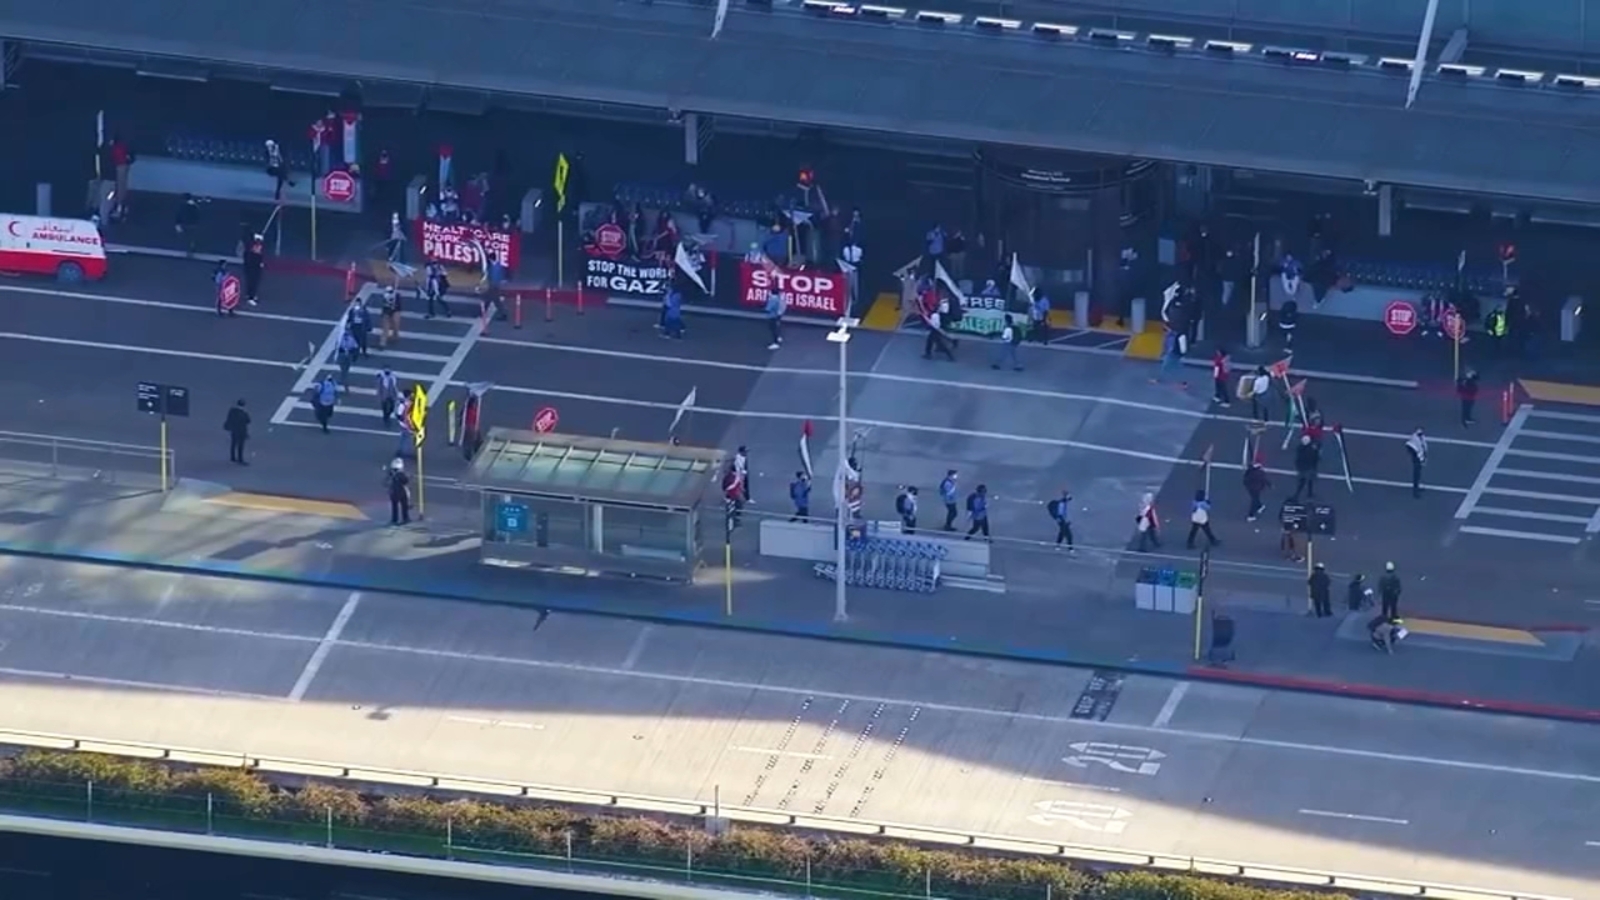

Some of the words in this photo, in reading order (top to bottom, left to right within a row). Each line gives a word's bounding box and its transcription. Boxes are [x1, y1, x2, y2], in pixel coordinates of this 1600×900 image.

[330, 179, 350, 191] STOP
[32, 232, 99, 245] AMBULANCE
[601, 230, 621, 243] STOP
[588, 260, 616, 273] STOP
[617, 264, 637, 278] THE
[587, 275, 608, 288] FOR
[609, 276, 667, 294] GAZ
[751, 269, 834, 294] STOP
[795, 293, 837, 311] ISRAEL
[1391, 309, 1412, 322] STOP
